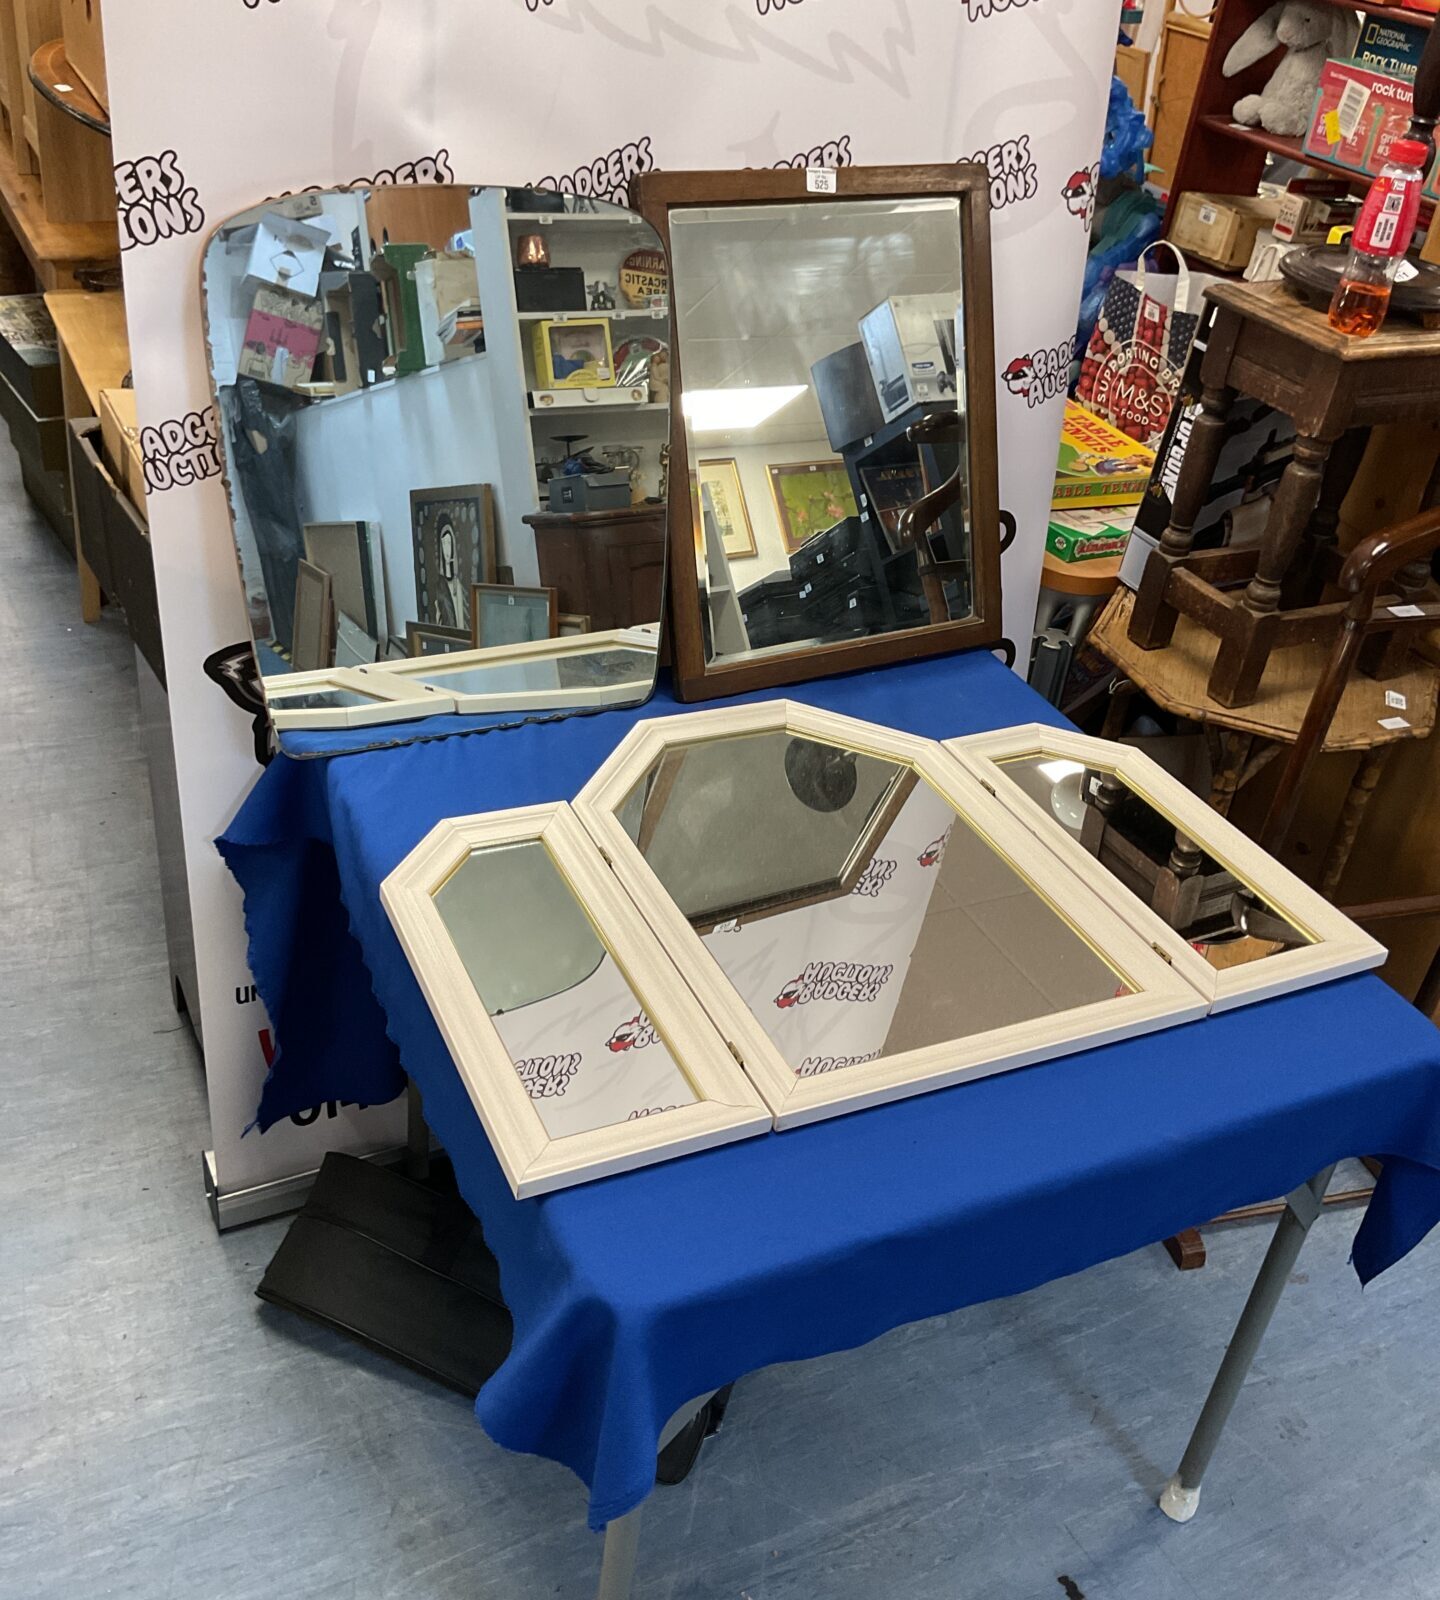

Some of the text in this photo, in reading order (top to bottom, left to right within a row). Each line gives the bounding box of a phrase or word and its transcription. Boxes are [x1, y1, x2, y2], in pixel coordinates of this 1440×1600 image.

[1379, 28, 1406, 42] NATIONAL
[1376, 37, 1410, 53] GEOGRAPHIC
[1362, 51, 1418, 76] ROCK TUMB
[1371, 82, 1397, 100] rock
[815, 180, 829, 190] 525
[1097, 347, 1159, 403] SUPPORTING
[1115, 379, 1164, 417] M&S
[1120, 409, 1149, 425] FOOD
[1069, 415, 1129, 447] TABLE
[1054, 486, 1092, 499] ABLE
